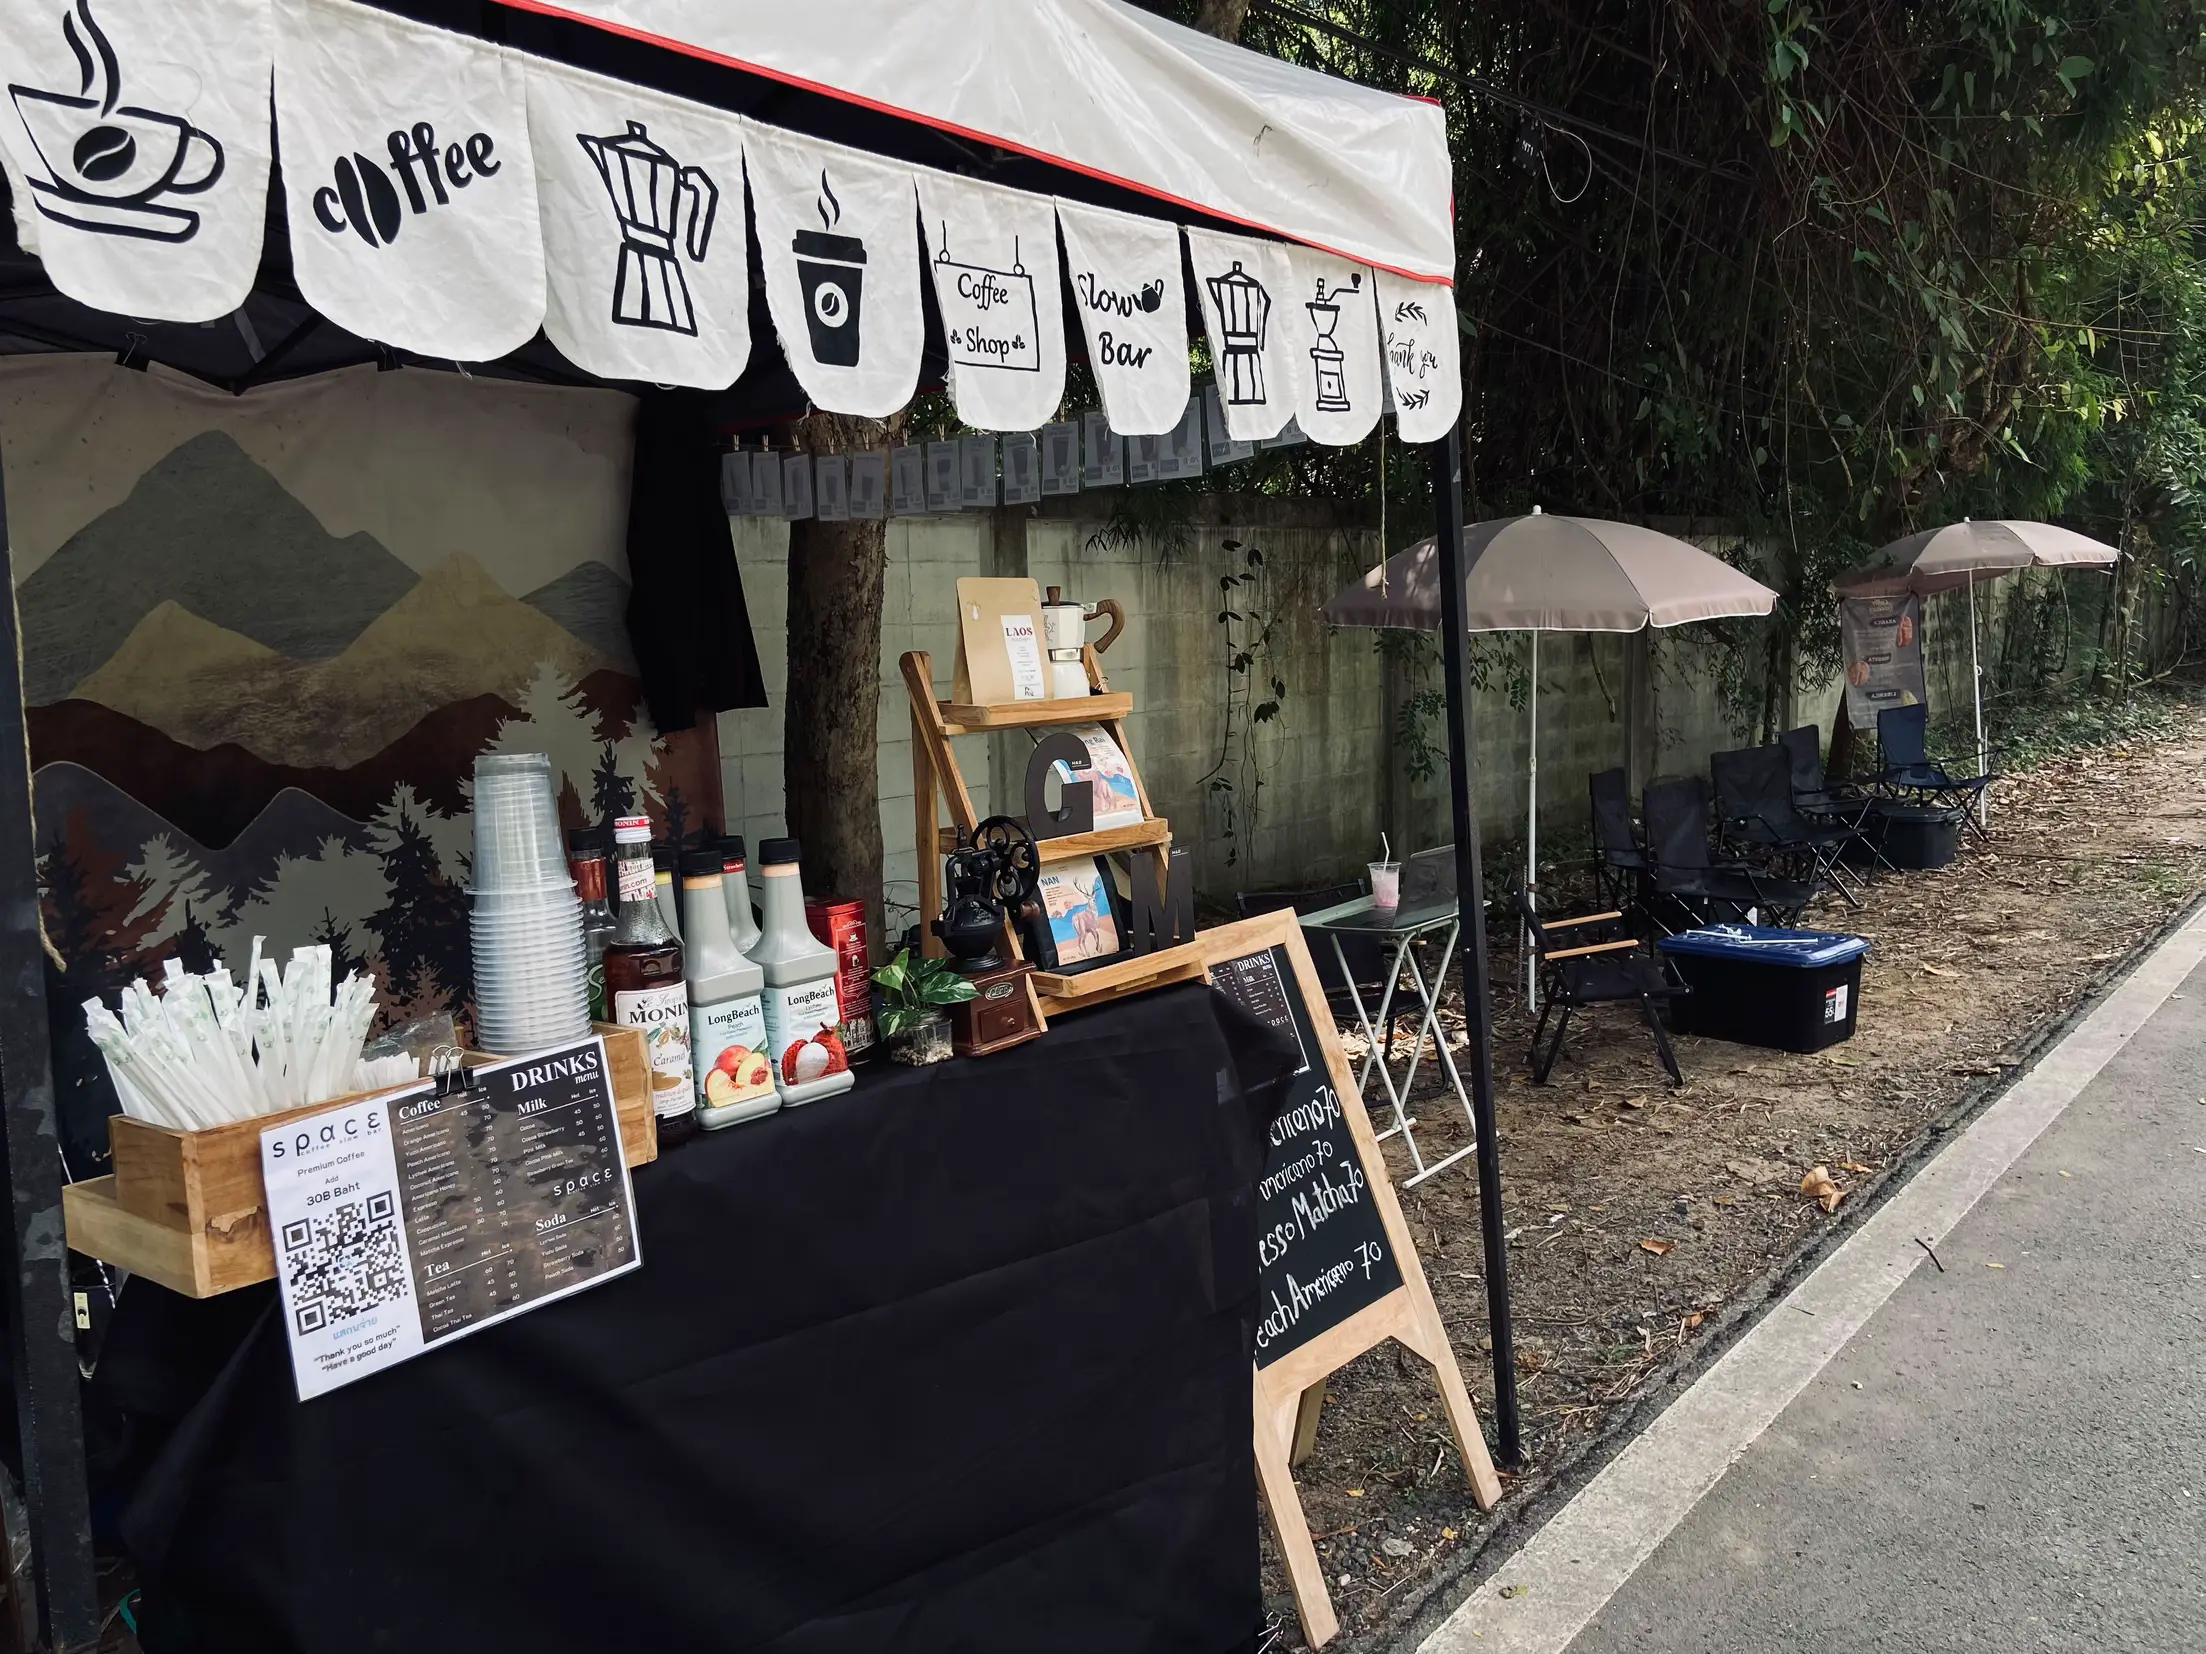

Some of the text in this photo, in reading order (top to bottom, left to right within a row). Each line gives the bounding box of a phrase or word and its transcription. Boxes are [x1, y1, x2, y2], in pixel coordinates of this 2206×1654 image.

[958, 273, 1008, 310] Coffee
[967, 326, 1009, 363] Shop
[1099, 332, 1152, 369] Bar
[1387, 332, 1438, 379] hank you
[1006, 627, 1033, 636] LAOS
[1041, 876, 1060, 887] NAN
[1237, 953, 1270, 972] DRINKS
[788, 987, 834, 1006] LongBeach
[629, 1002, 688, 1024] MONIN
[708, 1005, 760, 1025] LongBeach
[510, 1051, 598, 1092] DRINKS
[575, 1071, 599, 1084] menu
[399, 1100, 441, 1119] Coffee
[517, 1098, 547, 1116] Milk
[402, 1123, 429, 1135] Americano
[423, 1128, 450, 1140] Americano
[300, 1144, 330, 1155] coffee
[340, 1135, 358, 1144] slow
[420, 1140, 446, 1152] Americano
[535, 1143, 546, 1151] Milk
[1312, 1140, 1333, 1166] 70
[297, 1151, 365, 1177] Premium Coffee
[407, 1158, 423, 1168] Peach
[424, 1150, 450, 1162] Americano
[428, 1161, 455, 1172] Americano
[325, 1176, 339, 1185] Add
[432, 1170, 459, 1182] Americano
[1340, 1160, 1364, 1203] 70
[307, 1182, 360, 1206] 30B Baht
[412, 1189, 439, 1201] Americano
[440, 1183, 456, 1192] Honey
[535, 1214, 567, 1232] Soda
[555, 1244, 567, 1252] Soda
[572, 1250, 584, 1258] Soda
[424, 1261, 450, 1277] Tea
[1354, 1241, 1382, 1280] 70
[561, 1266, 574, 1274] Soda
[427, 1286, 446, 1296] Matcha
[447, 1280, 462, 1289] Latte
[429, 1300, 445, 1308] Green
[444, 1308, 454, 1316] Tea
[433, 1324, 449, 1333] Cocoa
[347, 1343, 362, 1354] you
[364, 1338, 374, 1346] so
[356, 1346, 376, 1361] good
